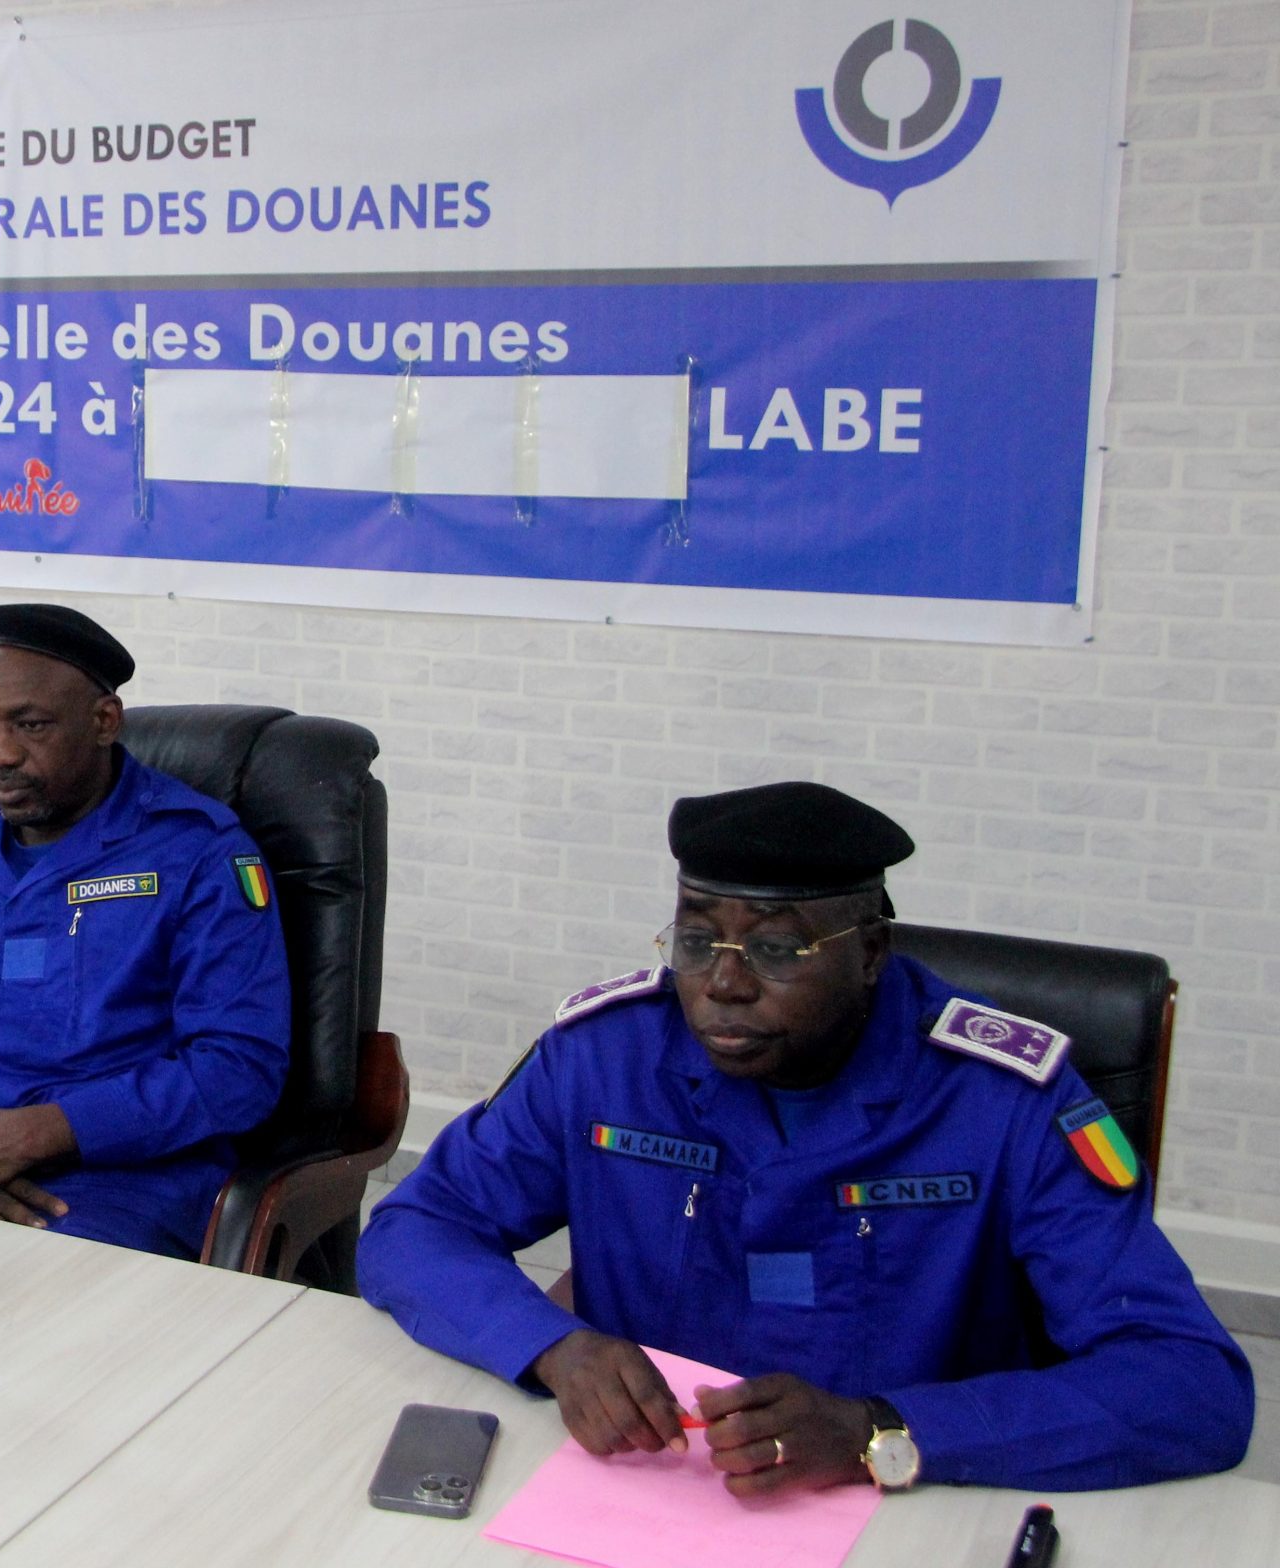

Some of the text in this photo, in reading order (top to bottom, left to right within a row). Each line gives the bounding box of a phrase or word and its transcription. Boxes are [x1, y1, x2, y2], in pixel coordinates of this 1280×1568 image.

[22, 127, 76, 167] DU
[91, 117, 257, 163] BUDGET
[123, 189, 208, 236] DES
[226, 179, 492, 234] DOUANES
[112, 303, 221, 361] des
[249, 303, 569, 363] Douanes
[81, 381, 116, 435] à
[709, 387, 923, 452] LABE
[79, 879, 136, 897] DOUANES
[869, 1180, 968, 1201] CNRD
